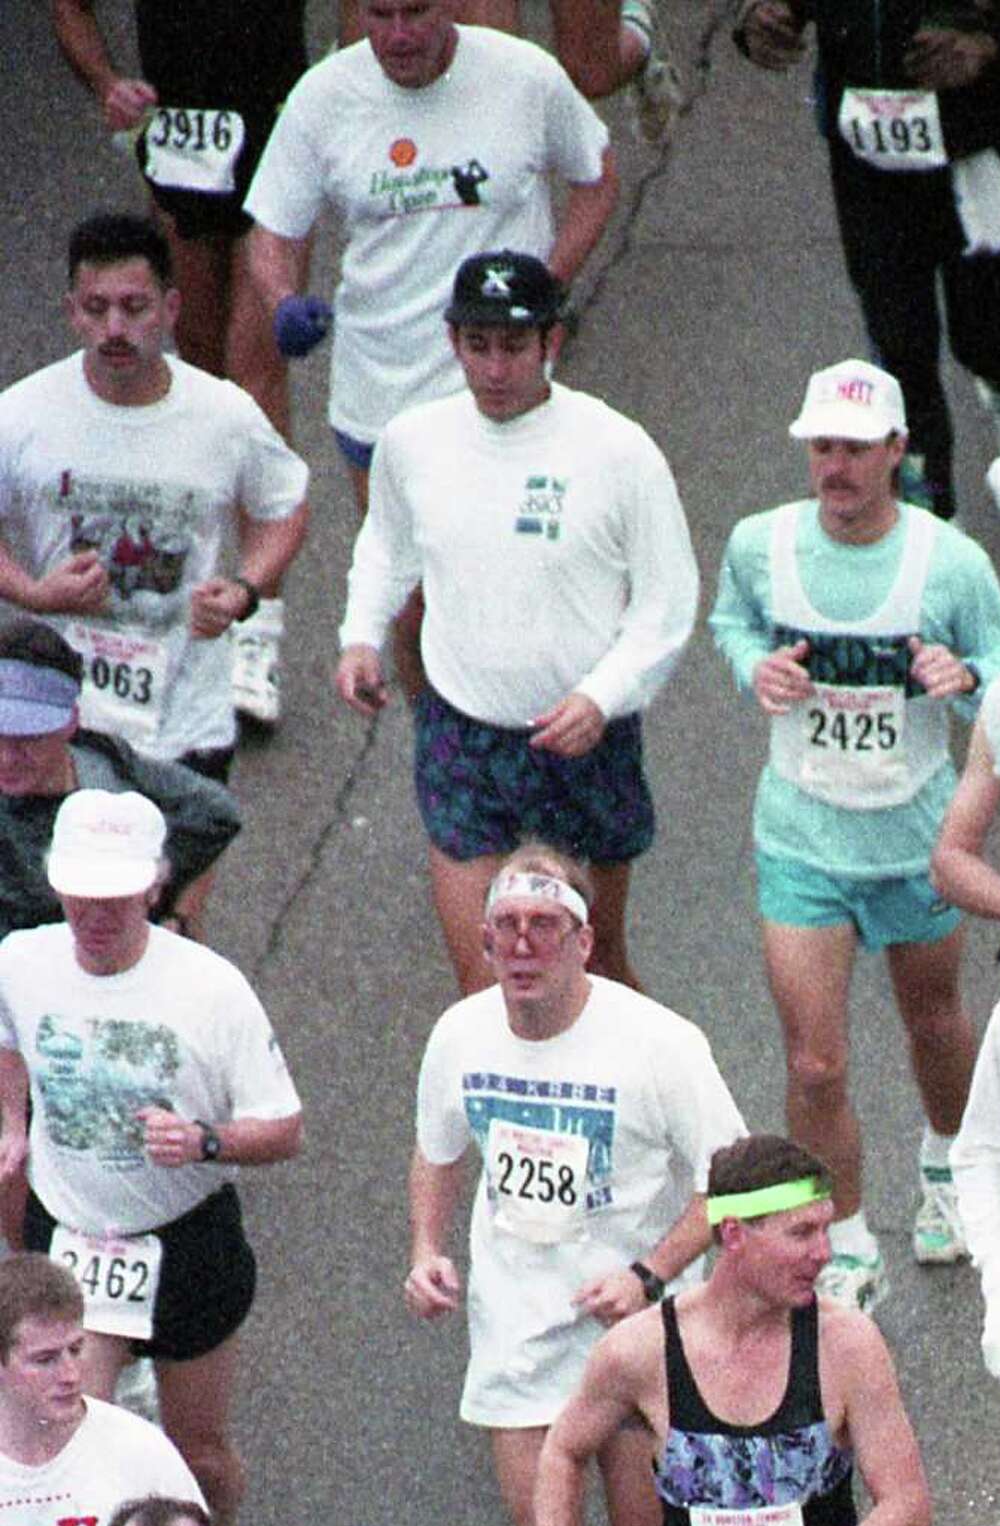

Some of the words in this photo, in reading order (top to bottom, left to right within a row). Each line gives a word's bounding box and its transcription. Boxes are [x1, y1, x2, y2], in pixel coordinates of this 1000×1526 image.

[152, 109, 232, 151] 3916
[851, 117, 931, 153] 1193
[83, 657, 153, 704] 063
[809, 708, 897, 751] 2425
[497, 1151, 577, 1207] 2258
